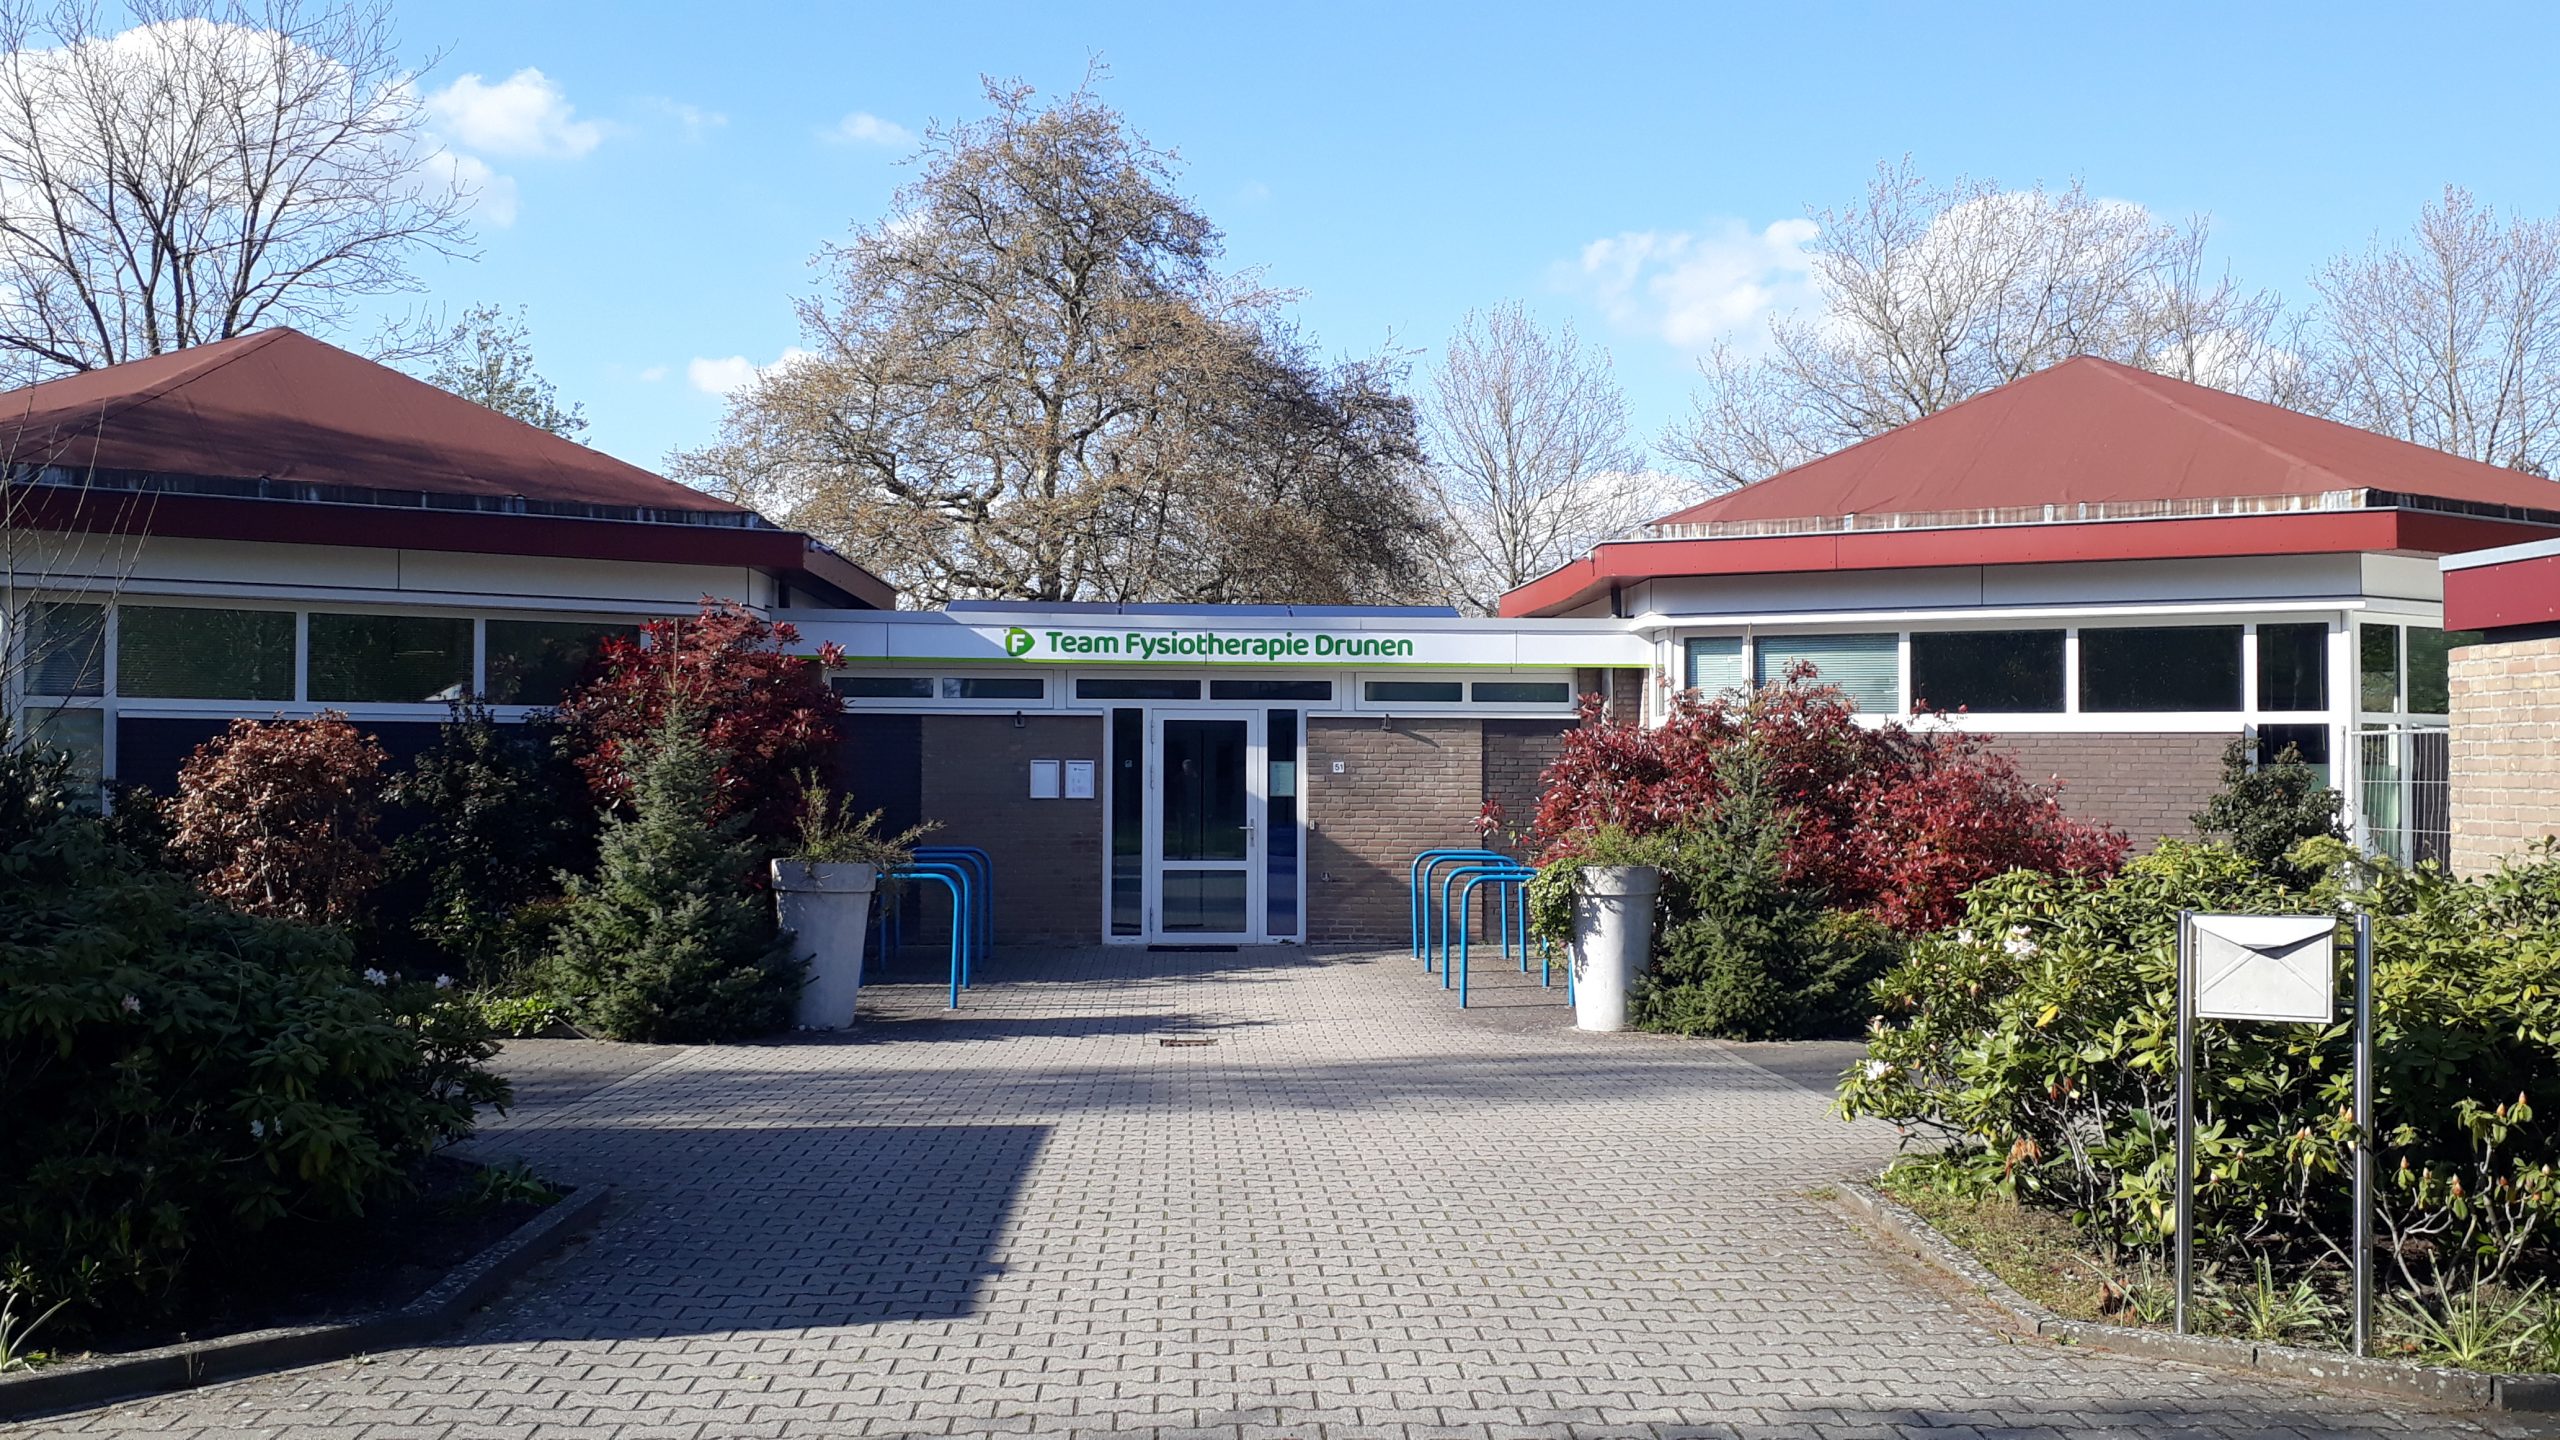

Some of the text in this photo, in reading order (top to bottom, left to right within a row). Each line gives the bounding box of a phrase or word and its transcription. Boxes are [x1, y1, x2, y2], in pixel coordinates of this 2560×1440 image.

[1047, 631, 1413, 660] Team Fysiotherapie Drunen
